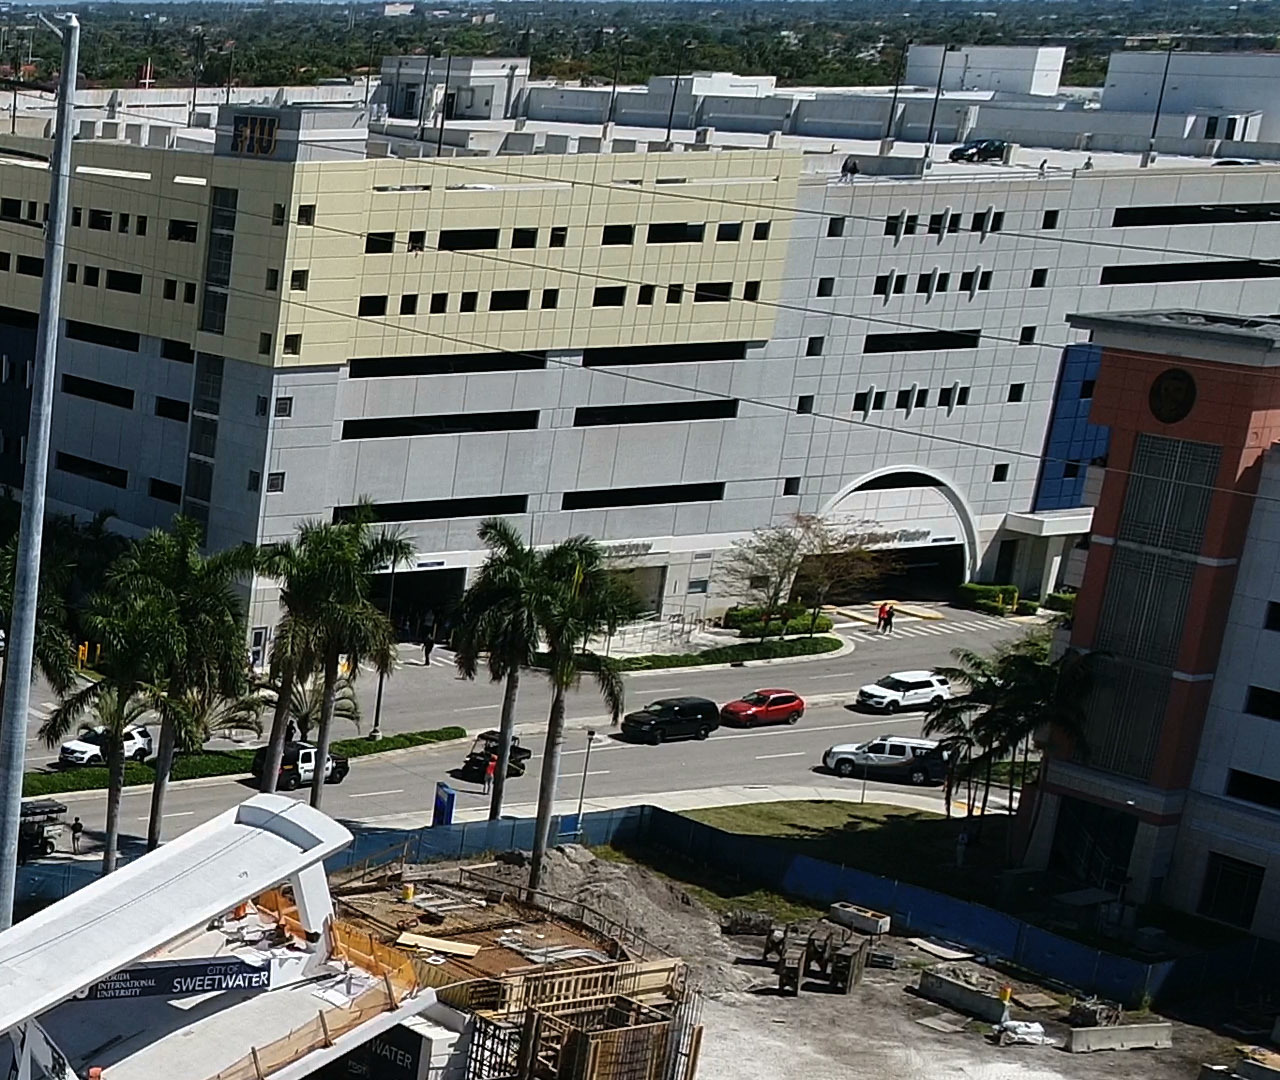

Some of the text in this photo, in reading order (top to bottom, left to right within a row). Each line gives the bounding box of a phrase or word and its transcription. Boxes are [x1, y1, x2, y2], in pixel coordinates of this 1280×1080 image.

[231, 115, 279, 154] FIU
[207, 964, 239, 975] CITY OF
[101, 973, 130, 982] LORIDA
[172, 971, 269, 993] SWEETWATER
[97, 978, 156, 990] INTERNATIONAL
[97, 988, 142, 998] UNIVERSITY
